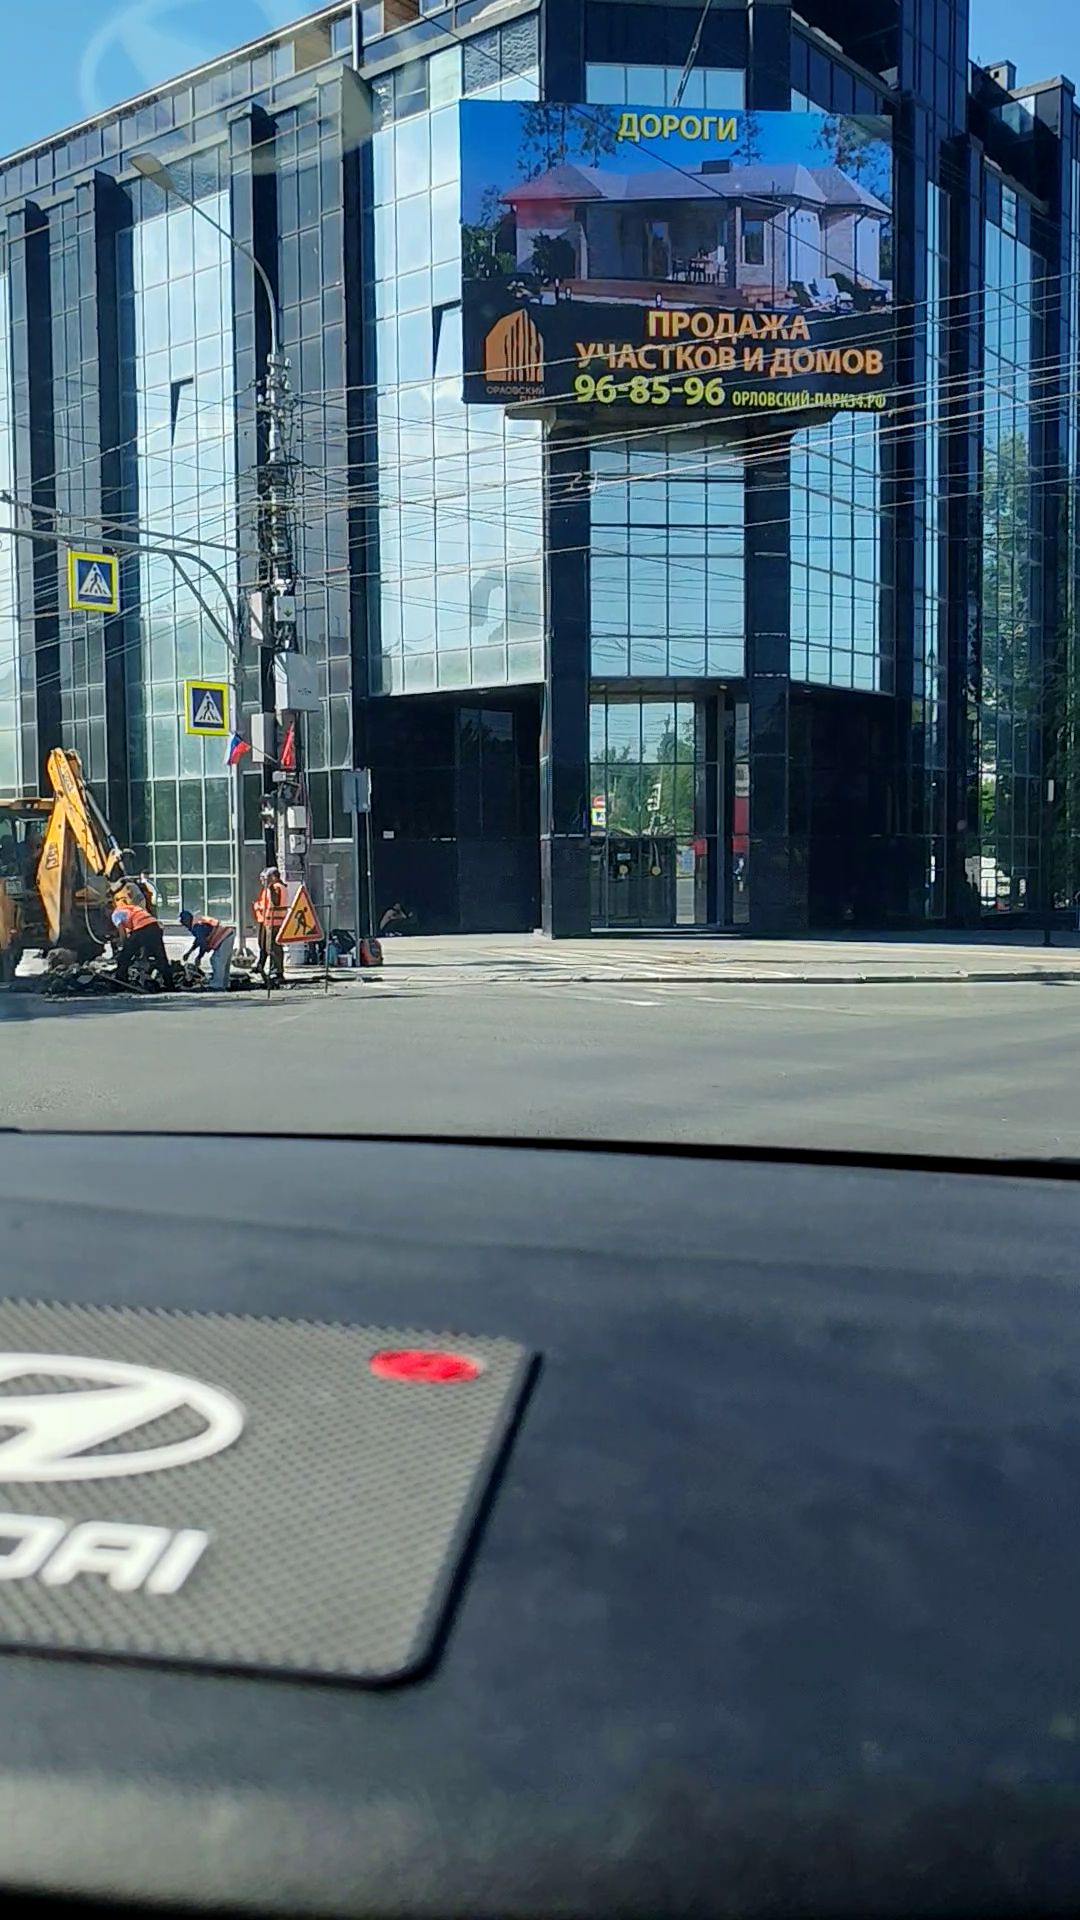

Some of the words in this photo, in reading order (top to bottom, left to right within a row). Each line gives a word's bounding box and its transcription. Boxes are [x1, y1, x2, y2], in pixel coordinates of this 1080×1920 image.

[617, 112, 738, 143] ДОРОГИ
[648, 310, 811, 344] ПРОДАЖА
[575, 342, 736, 371] УЧАСТКОВ
[743, 347, 764, 372] И
[769, 347, 884, 378] ДОМОВ
[574, 374, 726, 406] 96-85-96
